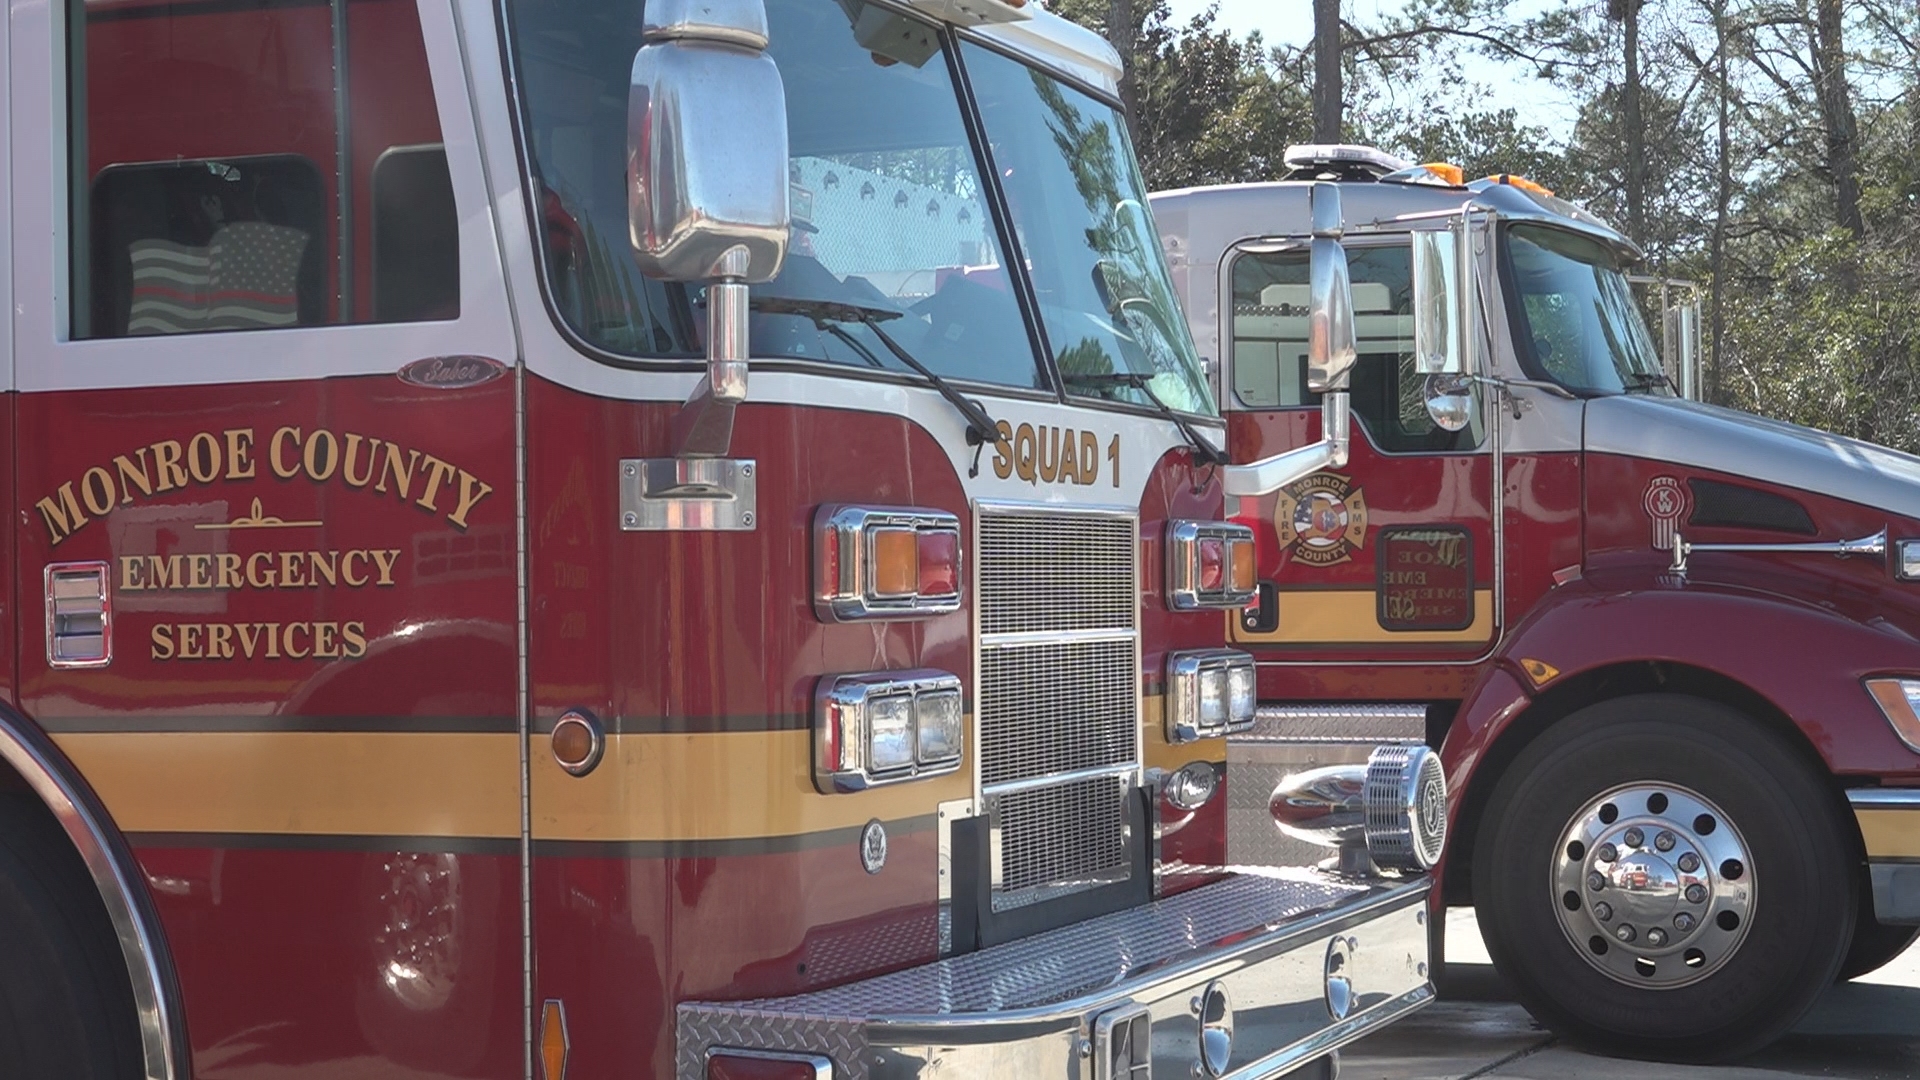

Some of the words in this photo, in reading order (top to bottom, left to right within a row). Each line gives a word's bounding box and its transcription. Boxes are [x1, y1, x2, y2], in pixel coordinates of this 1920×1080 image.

[992, 419, 1099, 487] SQUAD
[1107, 433, 1120, 488] 1
[36, 427, 256, 545] MONROE
[269, 425, 493, 531] COUNTY
[1293, 476, 1348, 494] MONROE
[1281, 499, 1290, 541] FIRE
[1352, 501, 1362, 536] EMS
[119, 549, 401, 590] EMERGENCY
[1295, 545, 1346, 562] COUNTY
[151, 620, 368, 660] SERVICES
